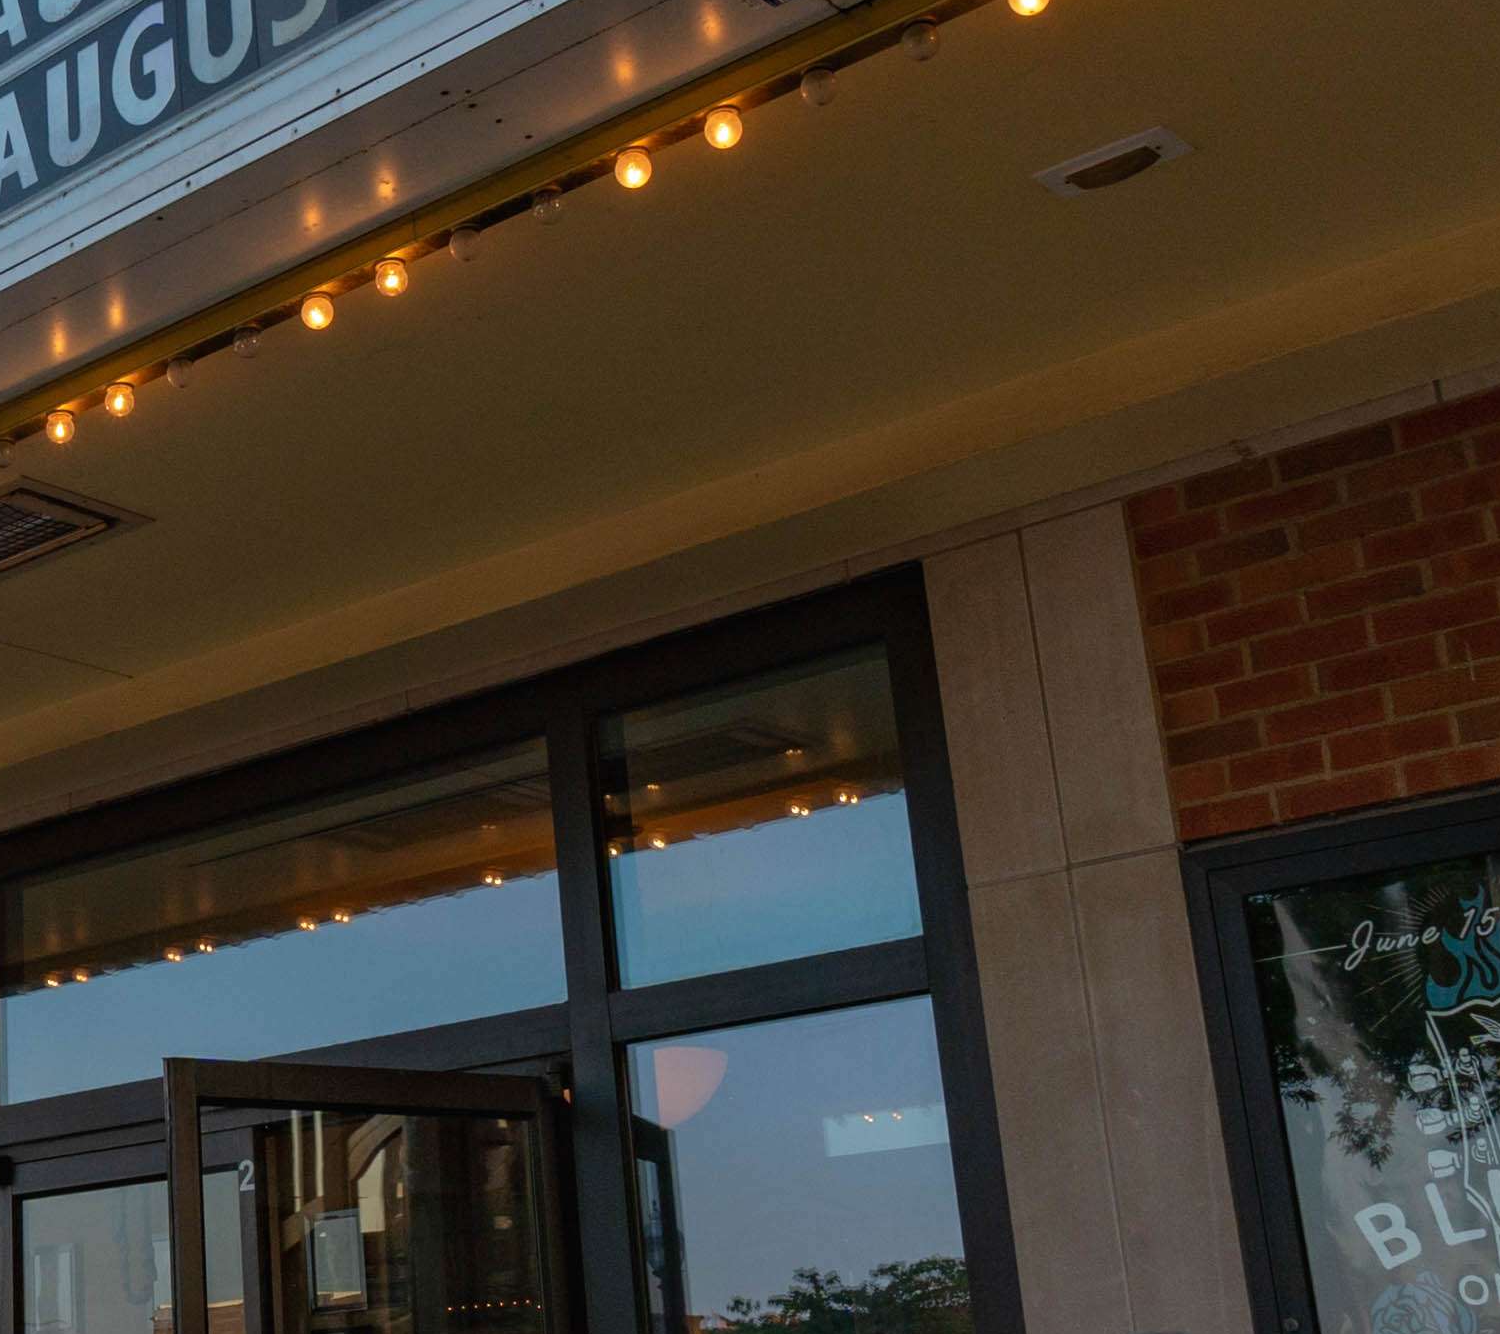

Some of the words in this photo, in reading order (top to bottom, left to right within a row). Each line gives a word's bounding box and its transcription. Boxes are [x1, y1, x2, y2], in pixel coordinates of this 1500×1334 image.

[1338, 920, 1441, 971] June
[1458, 906, 1498, 939] 15
[239, 1159, 255, 1192] 2
